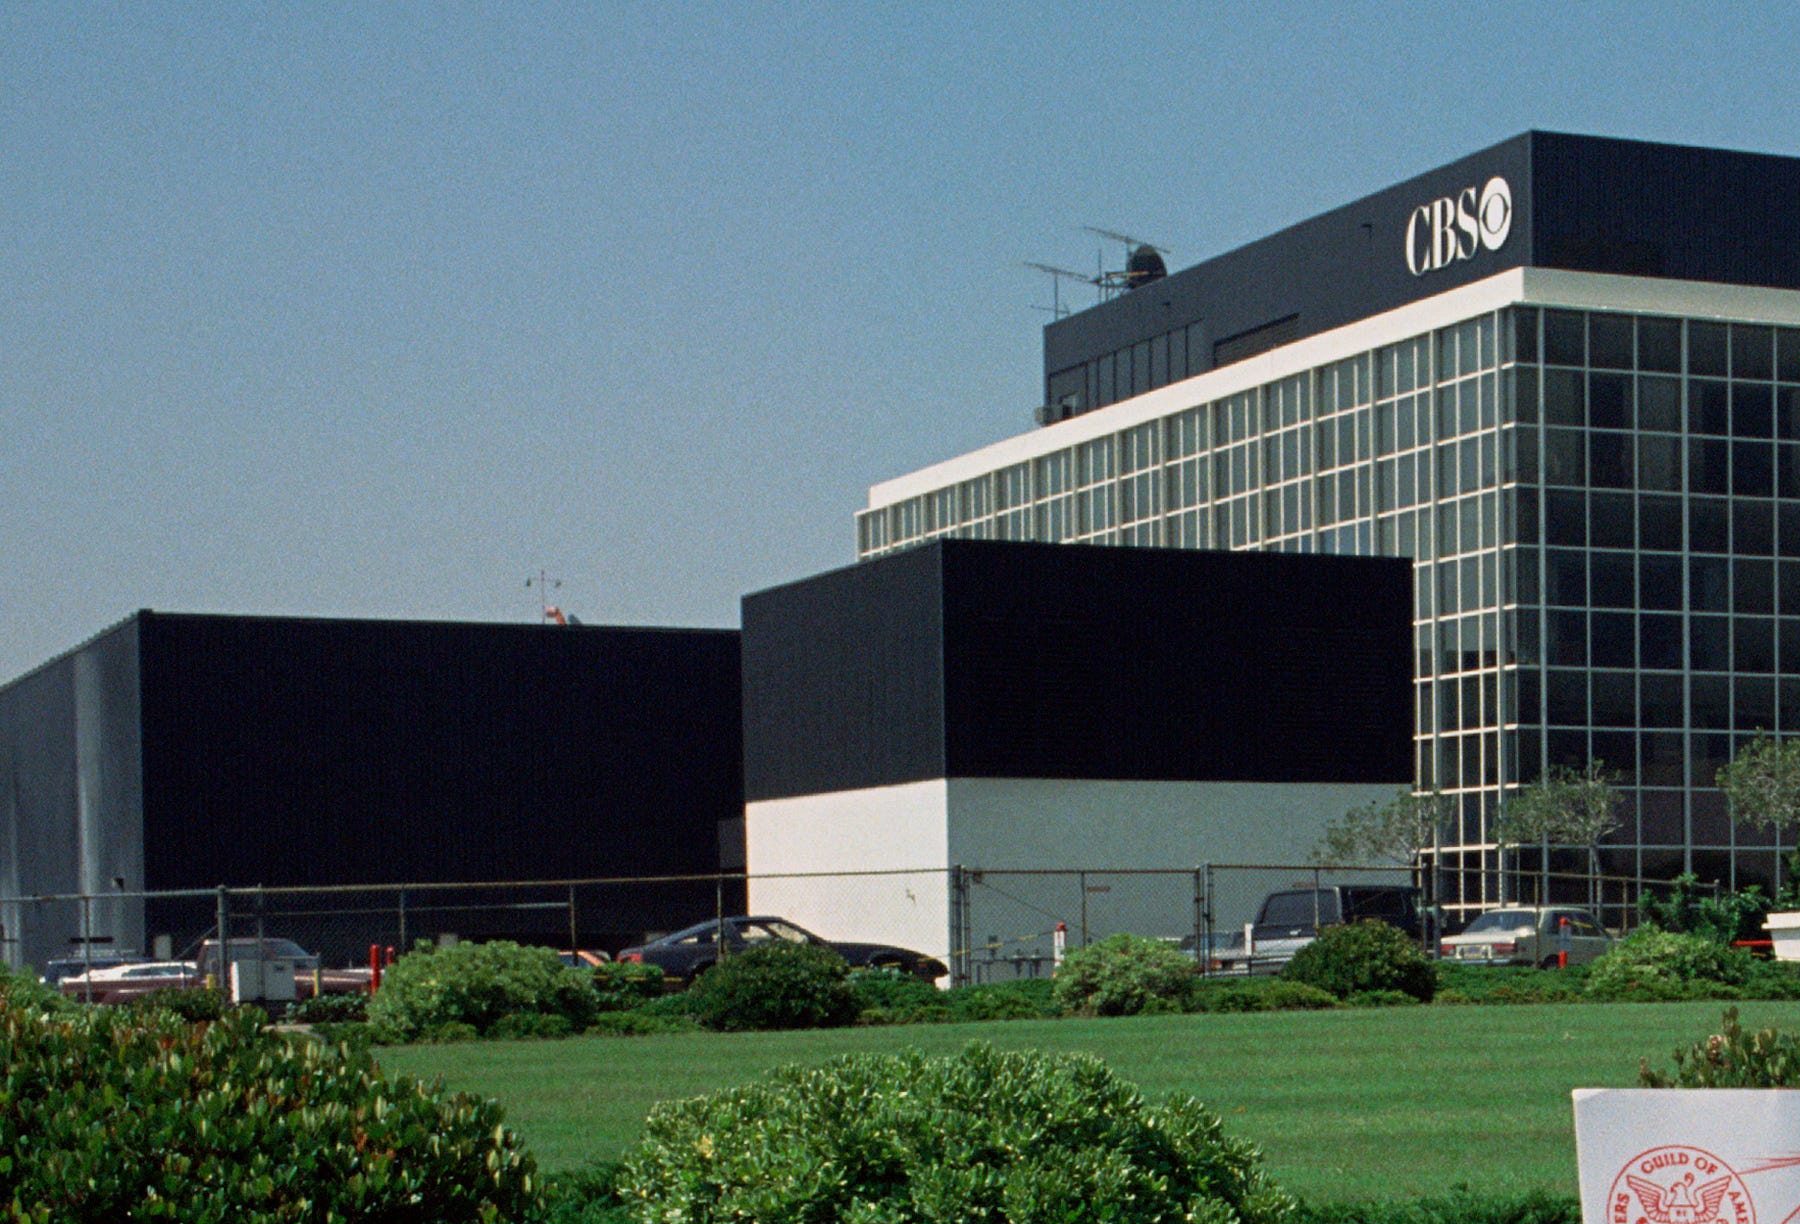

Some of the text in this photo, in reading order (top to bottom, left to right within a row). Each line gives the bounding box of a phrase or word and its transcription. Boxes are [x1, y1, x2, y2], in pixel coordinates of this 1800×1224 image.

[1406, 186, 1479, 277] CBS
[1640, 1152, 1689, 1174] GUILD
[1694, 1156, 1719, 1175] OF
